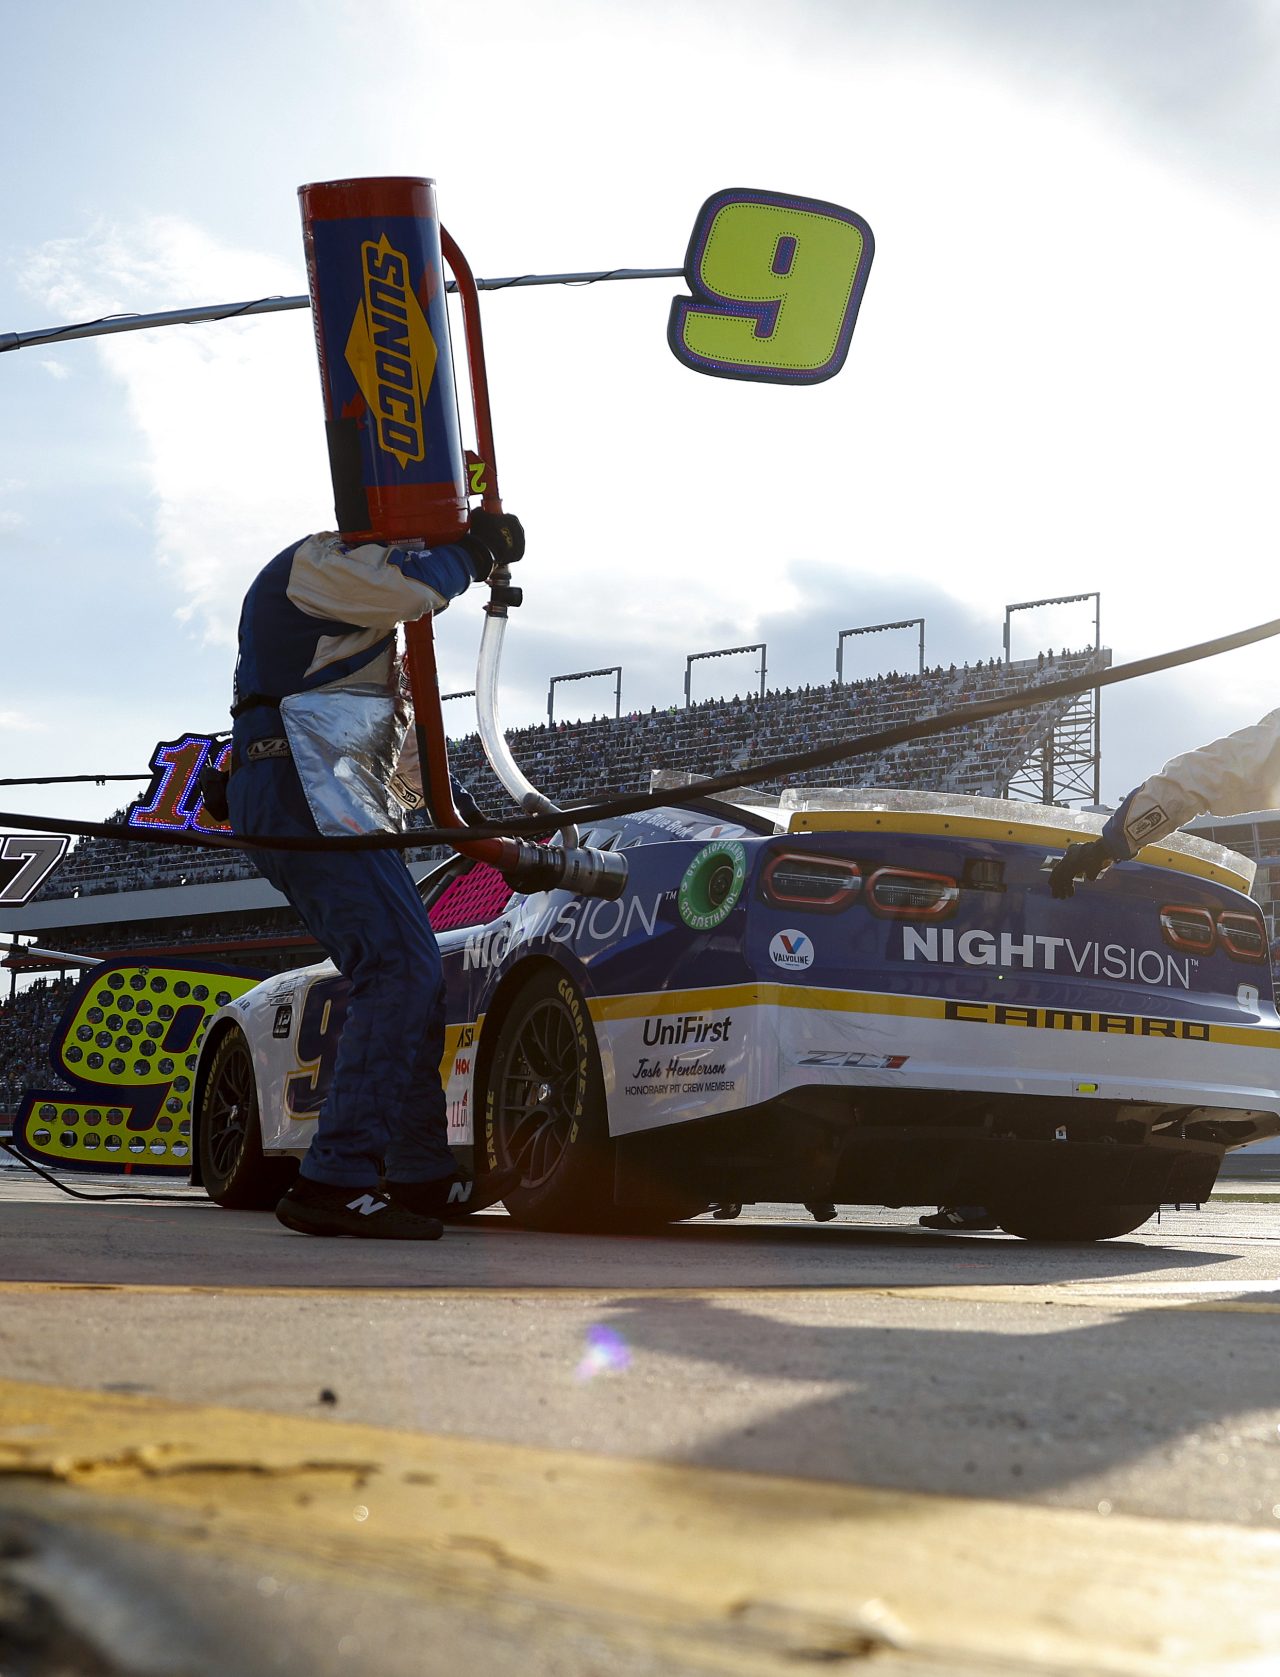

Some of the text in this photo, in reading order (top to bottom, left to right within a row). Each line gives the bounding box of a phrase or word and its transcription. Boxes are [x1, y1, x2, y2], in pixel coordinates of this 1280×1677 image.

[678, 195, 868, 376] 9
[364, 245, 419, 458] SUNOCO
[469, 463, 487, 493] 2
[646, 813, 672, 828] Blue
[665, 819, 694, 838] Book
[772, 951, 810, 966] VALVOLINE
[1237, 983, 1260, 1015] 9
[642, 1015, 733, 1047] UniFirst
[944, 1000, 1210, 1042] CAMARO
[24, 964, 266, 1166] 9
[632, 1057, 726, 1079] Josh Henderson
[625, 1081, 735, 1096] HONORARY PIT CREW MEMBER
[486, 1089, 498, 1171] EAGLE
